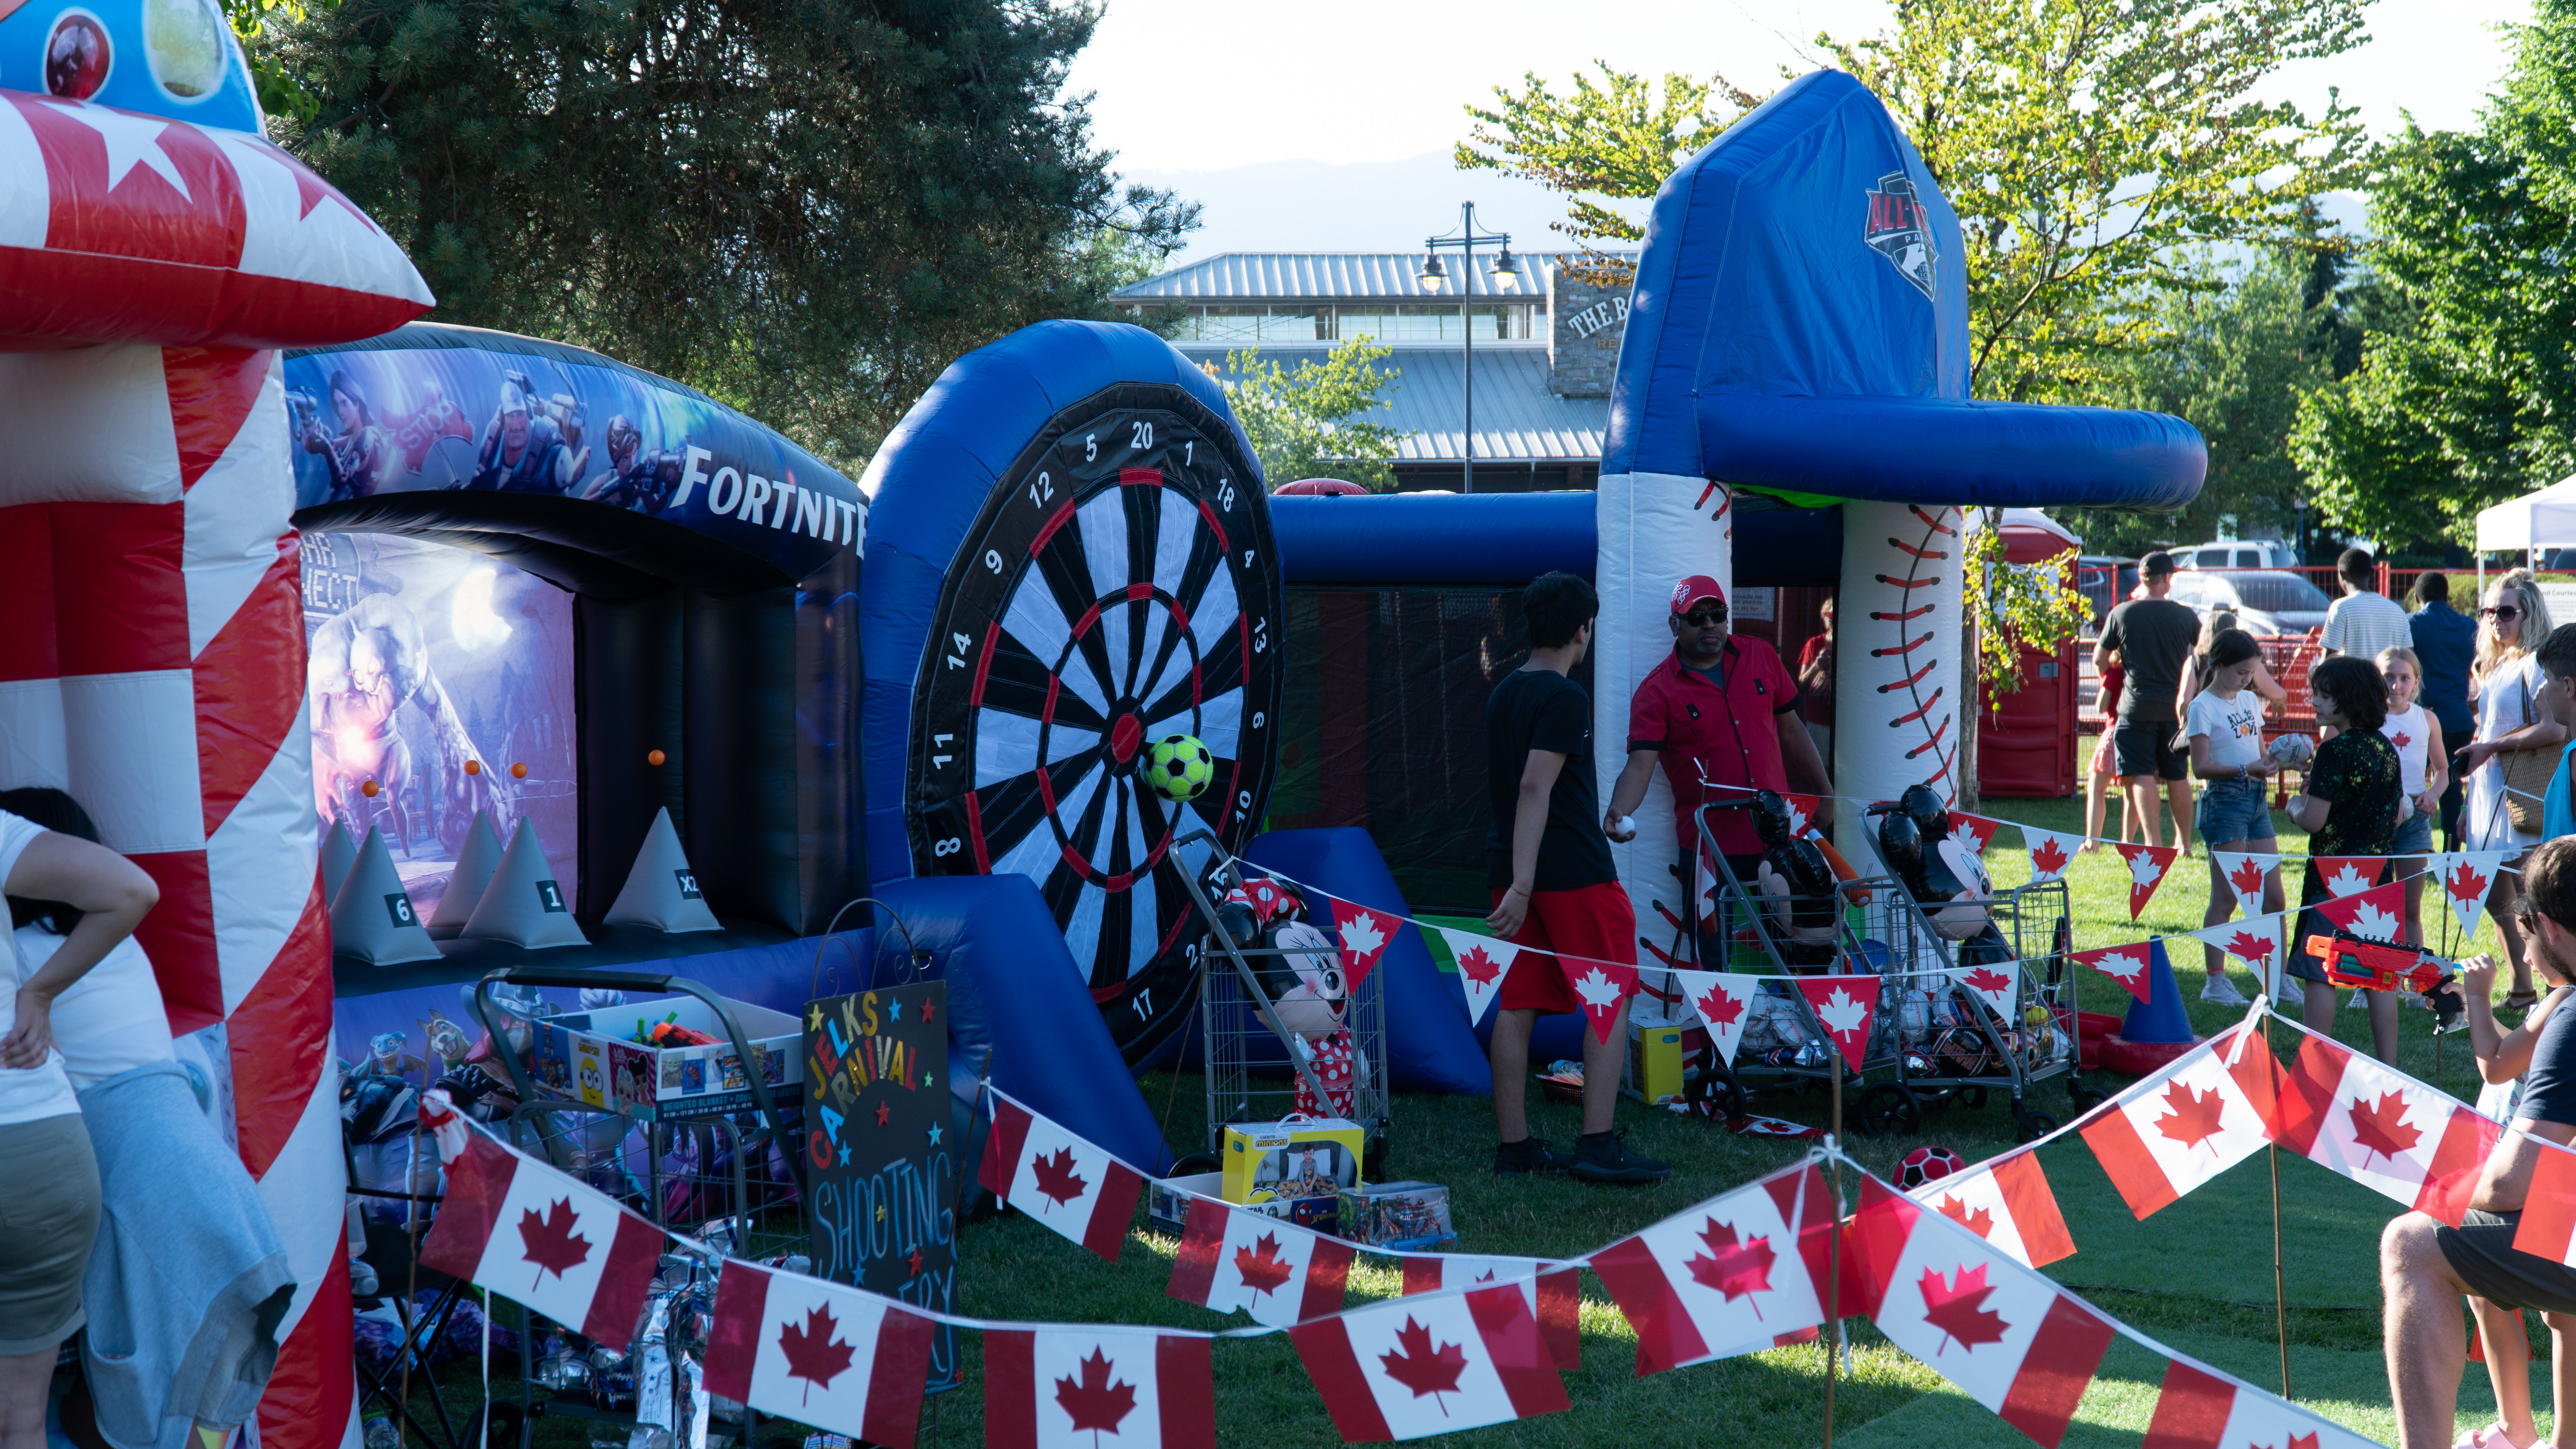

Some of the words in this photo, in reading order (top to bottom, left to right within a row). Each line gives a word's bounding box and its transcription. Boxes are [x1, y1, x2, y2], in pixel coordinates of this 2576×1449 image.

[1869, 195, 1921, 234] ALL-
[1568, 301, 1613, 339] THE
[1613, 296, 1631, 321] B
[1597, 339, 1621, 349] RE
[400, 399, 453, 449] STOP
[1130, 421, 1153, 450] 20
[1086, 433, 1097, 462] 5
[1185, 440, 1193, 467] 1
[669, 444, 869, 561] FORTNITE
[1030, 471, 1054, 509] 12
[1217, 478, 1234, 512] 18
[985, 549, 1002, 574] 9
[1245, 550, 1255, 568] 4
[1255, 617, 1267, 653] 13
[947, 632, 971, 670] 14
[1253, 712, 1264, 729] 6
[2227, 713, 2248, 729] ALL
[933, 734, 953, 770] 11
[1236, 790, 1251, 823] 10
[935, 837, 961, 857] 8
[547, 886, 561, 907] 1
[682, 876, 698, 892] X2
[1211, 872, 1228, 900] 15
[396, 899, 410, 921] 6
[1186, 944, 1198, 970] 2
[1133, 988, 1153, 1022] 17
[809, 992, 878, 1100] JELKS
[1941, 1044, 1975, 1070] BROWNS
[662, 1099, 697, 1111] WEIGHTED
[698, 1095, 727, 1107] BLANKET
[810, 1035, 916, 1170] CARNIVAL
[817, 1152, 958, 1281] SHOOTING
